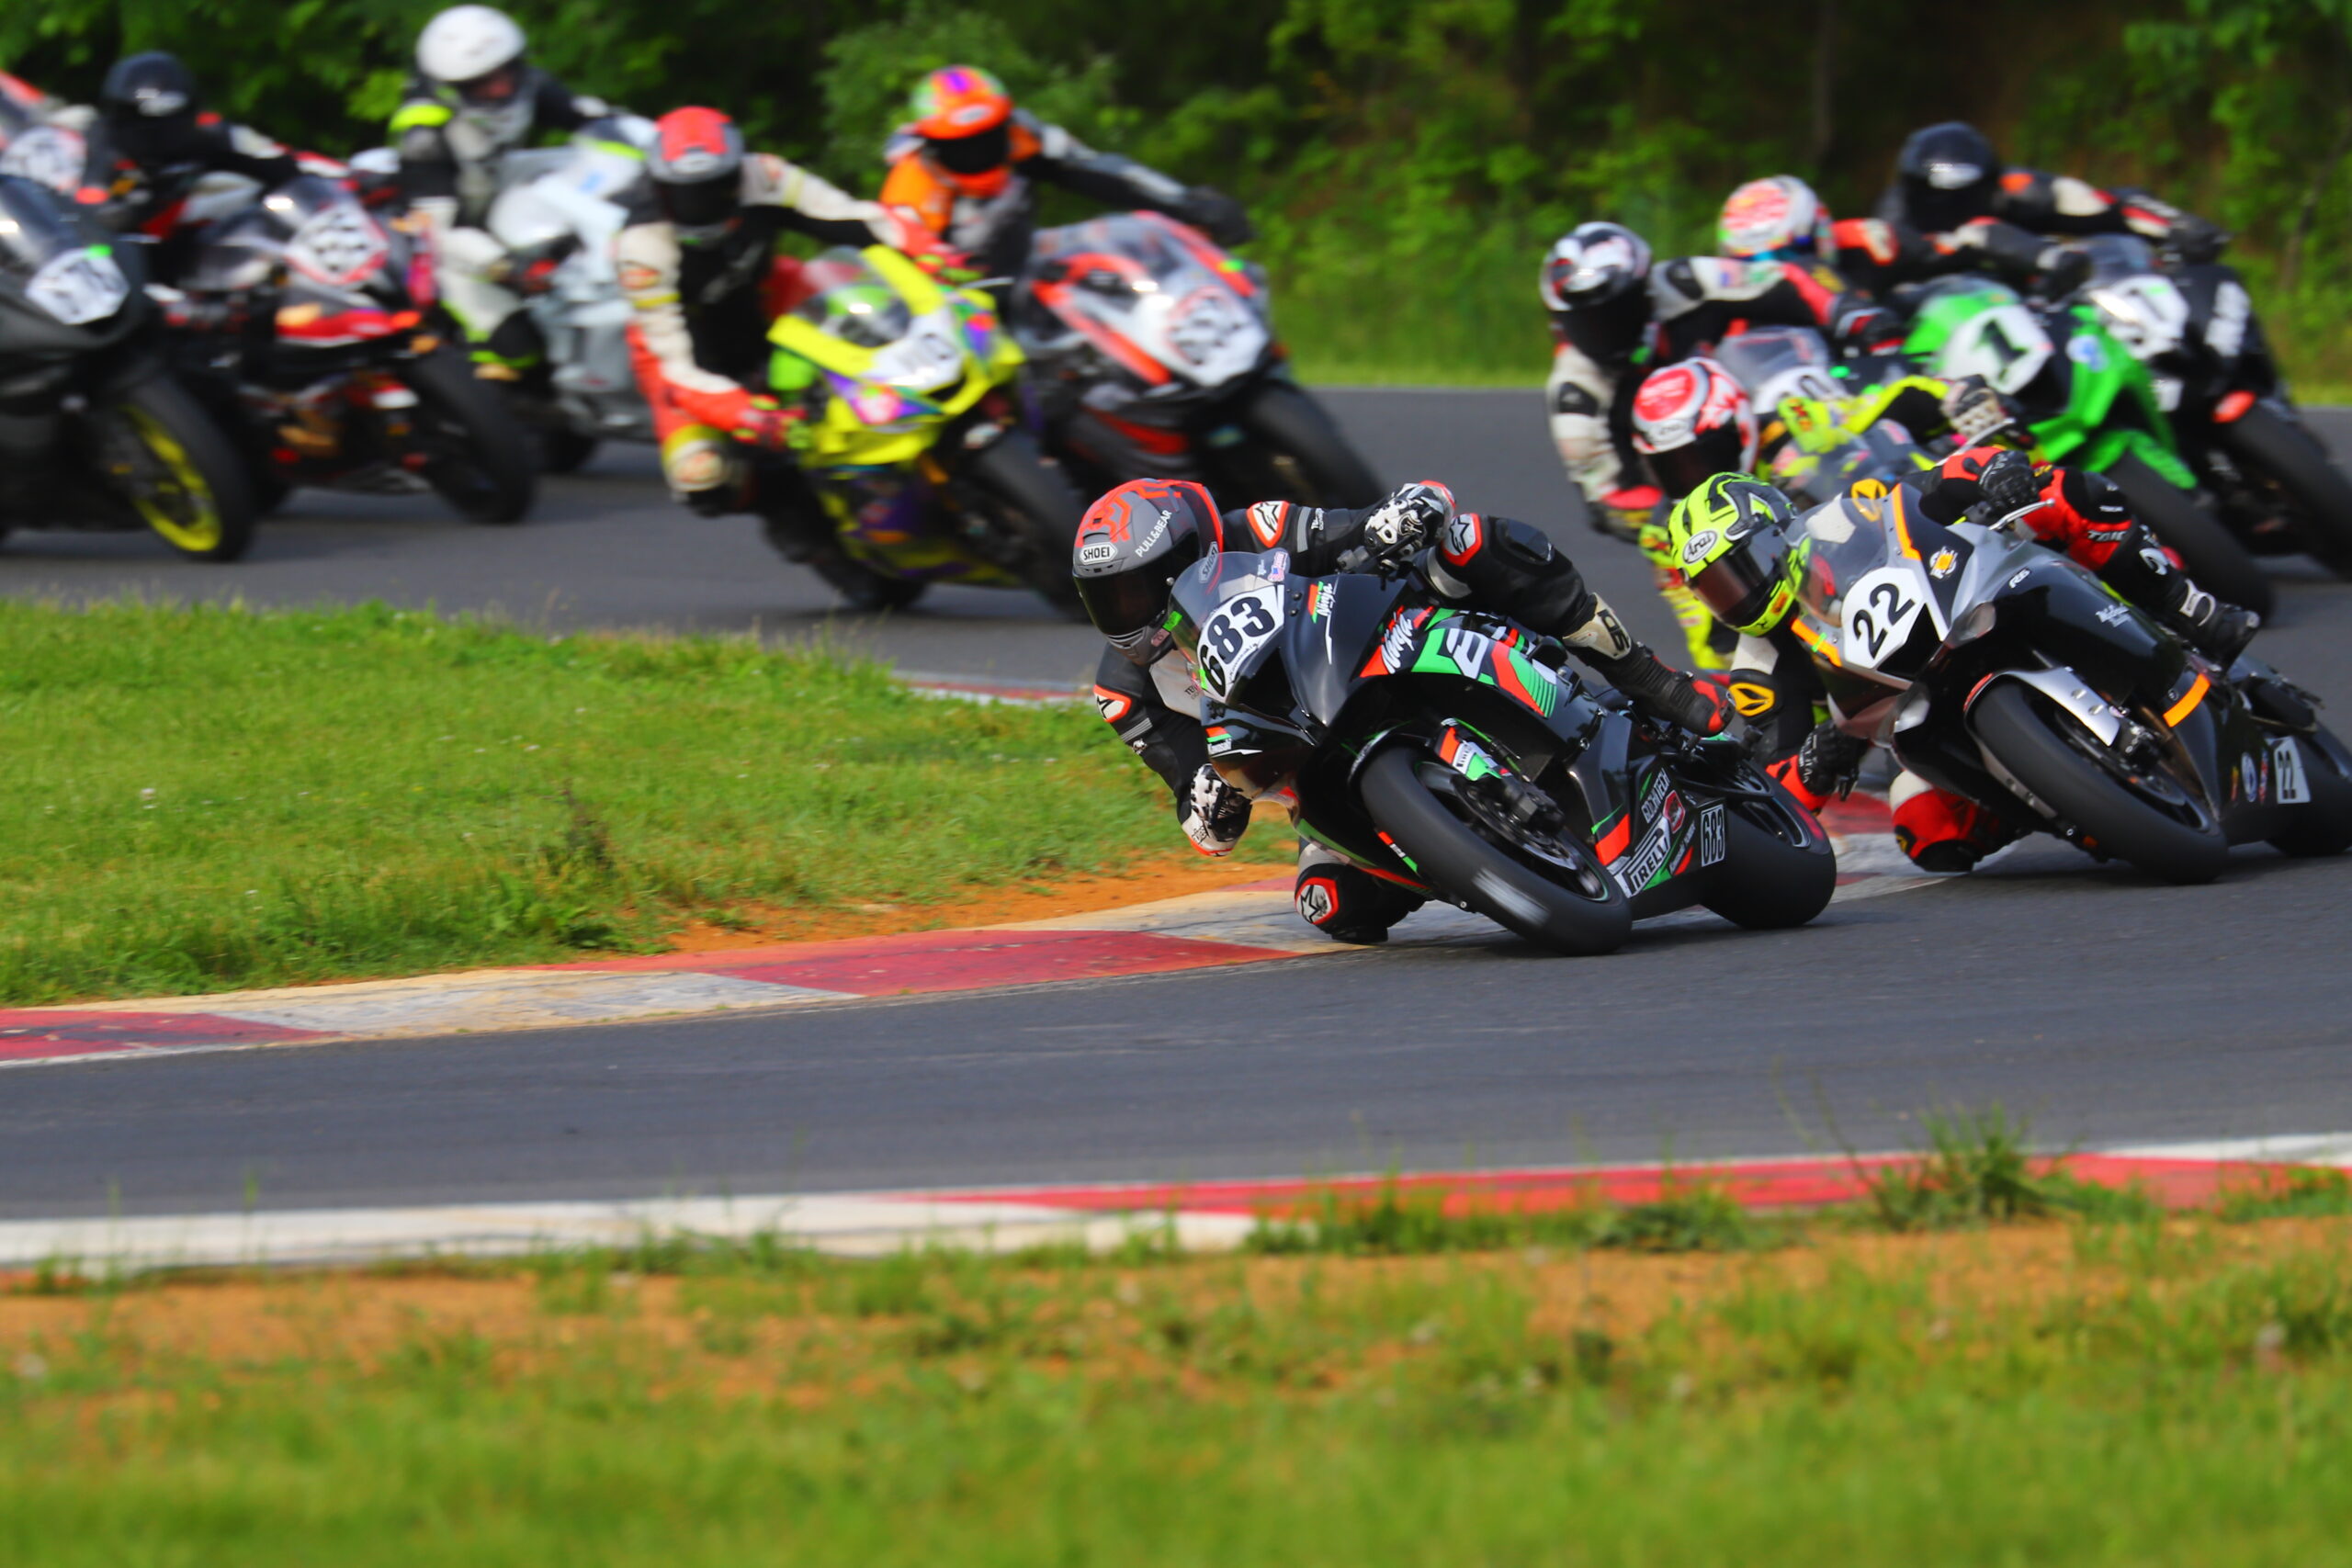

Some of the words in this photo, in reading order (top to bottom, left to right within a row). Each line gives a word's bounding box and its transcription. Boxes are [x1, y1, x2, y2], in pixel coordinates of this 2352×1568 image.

[1083, 546, 1111, 560] SHOEI
[1135, 509, 1173, 558] PULL&BEAR
[1688, 534, 1712, 558] Arai
[1200, 596, 1275, 697] 683
[1381, 612, 1415, 674] Ninja
[1853, 582, 1915, 660] 22
[1702, 808, 1724, 864] 683
